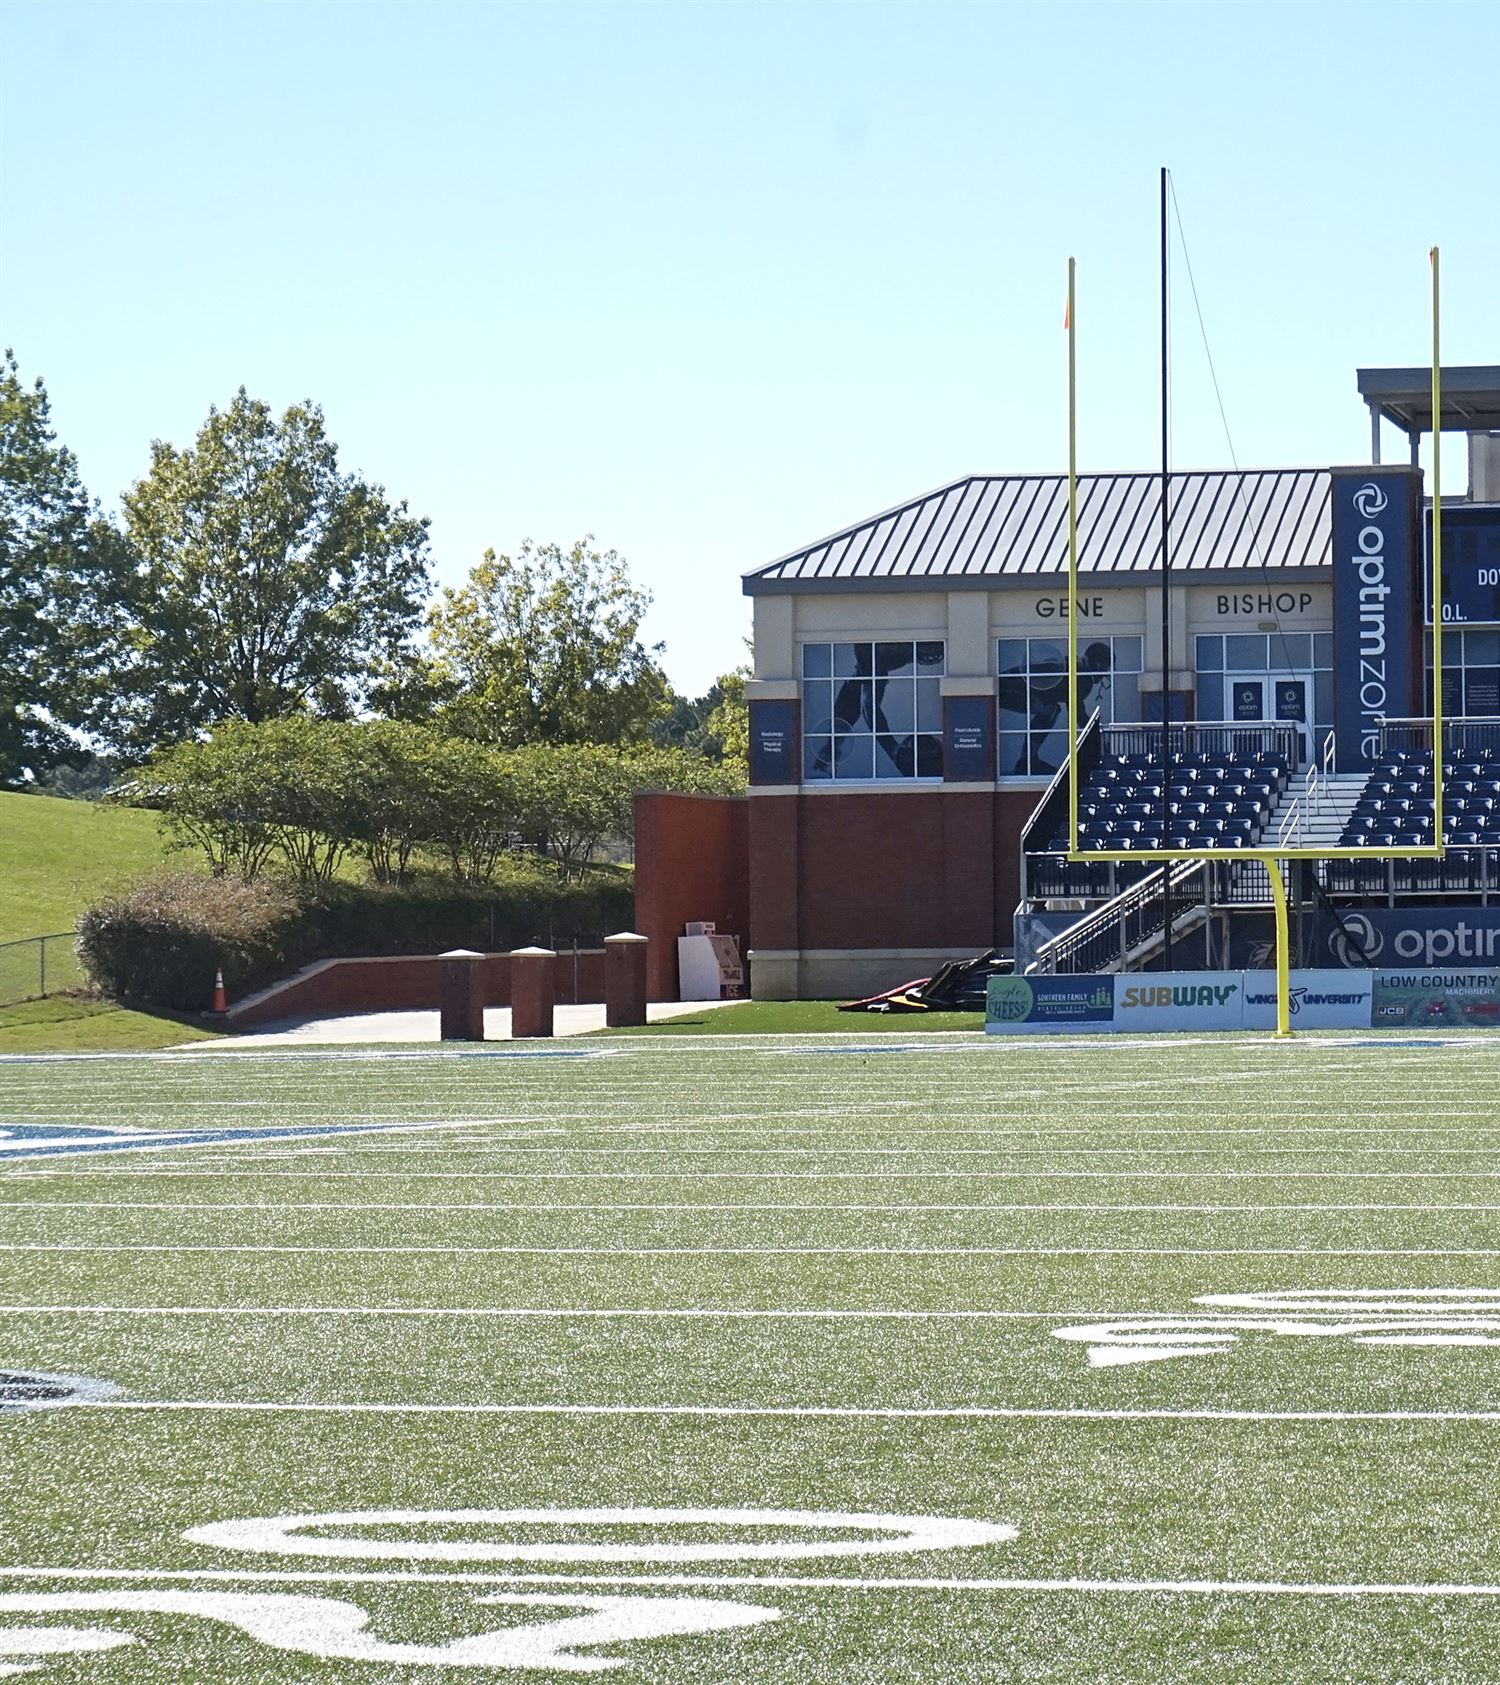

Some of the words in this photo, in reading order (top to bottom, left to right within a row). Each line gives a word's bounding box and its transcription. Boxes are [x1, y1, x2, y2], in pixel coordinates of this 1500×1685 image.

[1036, 598, 1103, 618] GENE
[1217, 593, 1312, 614] BISHOP
[1352, 526, 1391, 759] optimzone
[1381, 976, 1416, 988] LOW
[1421, 975, 1498, 987] COUNTRY
[1120, 984, 1238, 1008] SUBWAY
[1445, 988, 1496, 996] MACHINERY
[1303, 994, 1363, 1004] UNIVERSITY
[1379, 1007, 1405, 1015] JCB
